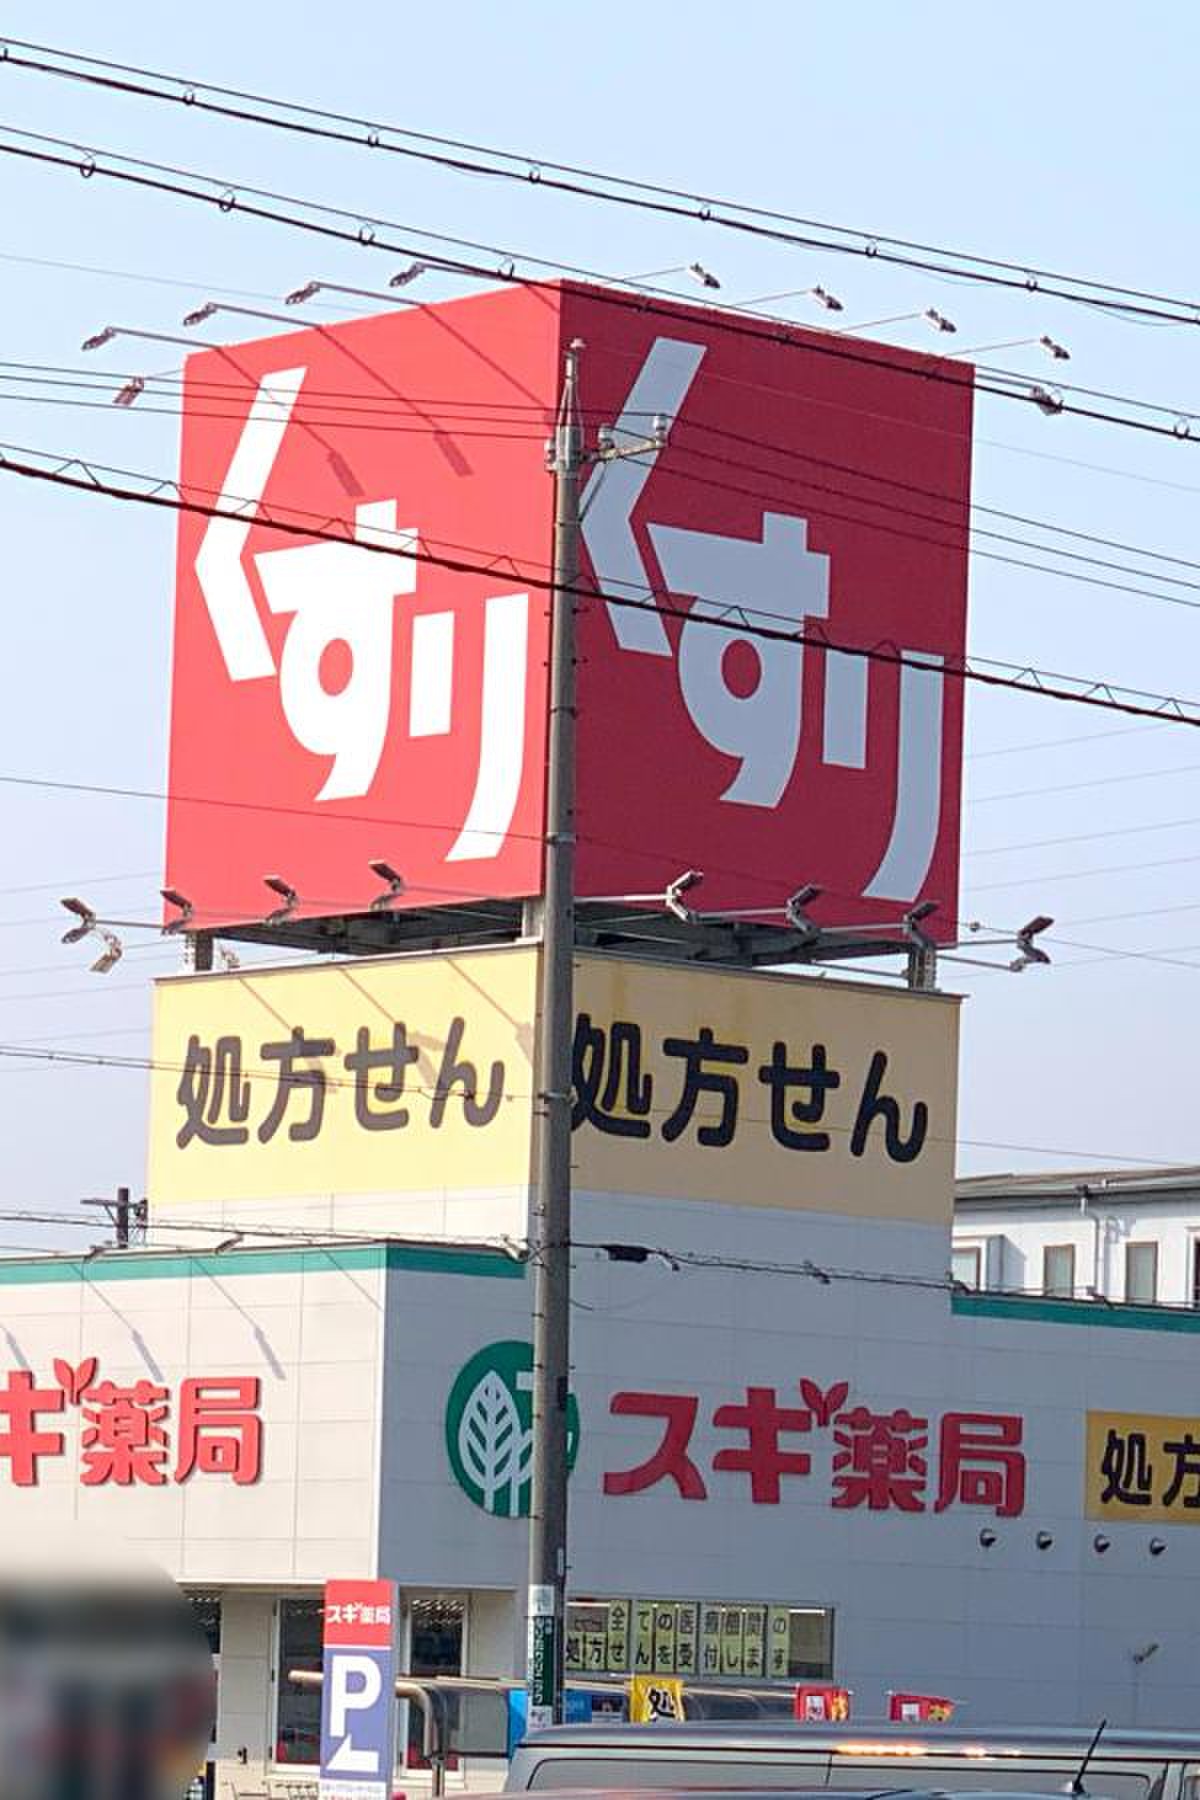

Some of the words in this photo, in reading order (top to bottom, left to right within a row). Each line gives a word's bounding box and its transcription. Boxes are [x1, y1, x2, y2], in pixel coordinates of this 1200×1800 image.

[195, 366, 530, 864] くすり
[579, 336, 945, 904] くすり
[176, 1015, 505, 1151] 処方せん
[571, 1012, 928, 1164] 処方せん
[603, 1377, 1028, 1518] スギ薬局
[325, 1601, 392, 1626] スギ薬局
[330, 1654, 383, 1739] P
